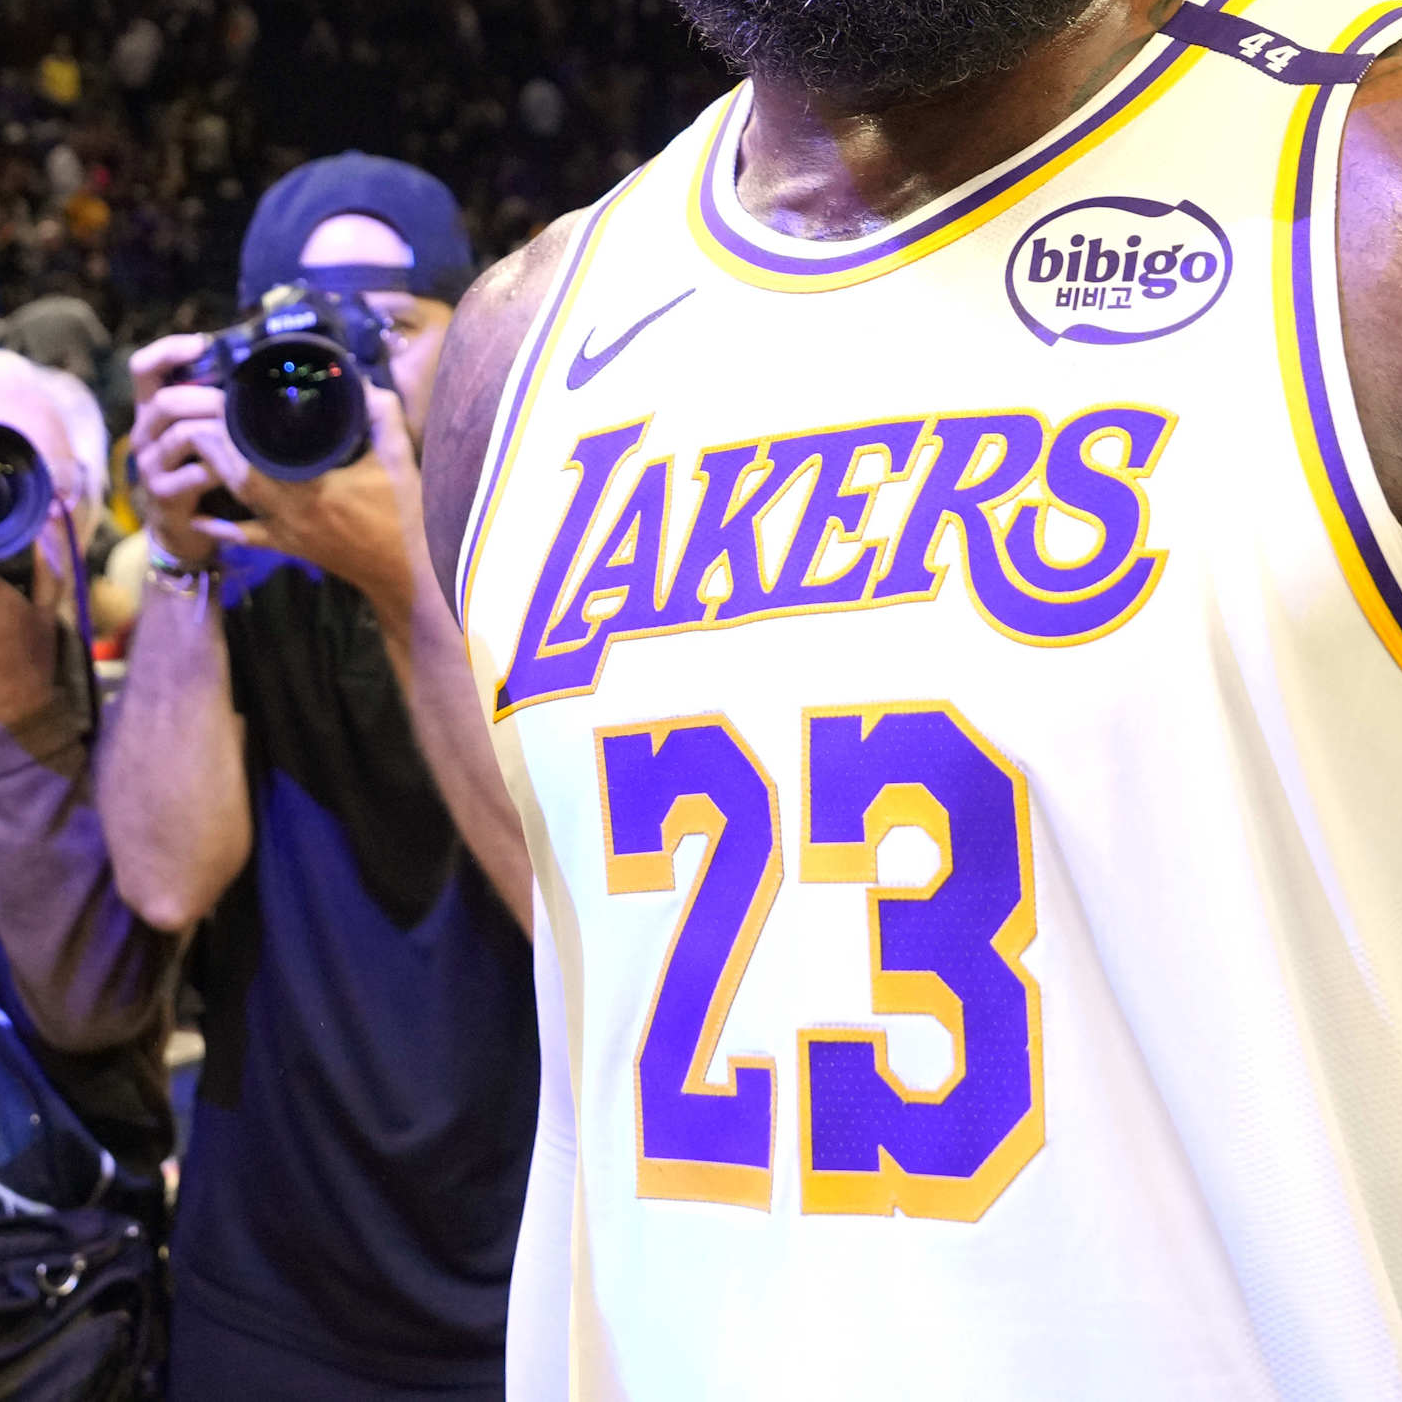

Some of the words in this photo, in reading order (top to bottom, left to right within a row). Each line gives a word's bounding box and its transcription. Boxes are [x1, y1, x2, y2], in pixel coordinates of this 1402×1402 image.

[1238, 32, 1301, 74] 44
[1028, 234, 1218, 299] bibigo
[1055, 287, 1132, 311] 비비고
[493, 400, 1180, 724] LAKERS
[592, 698, 1045, 1223] 23
